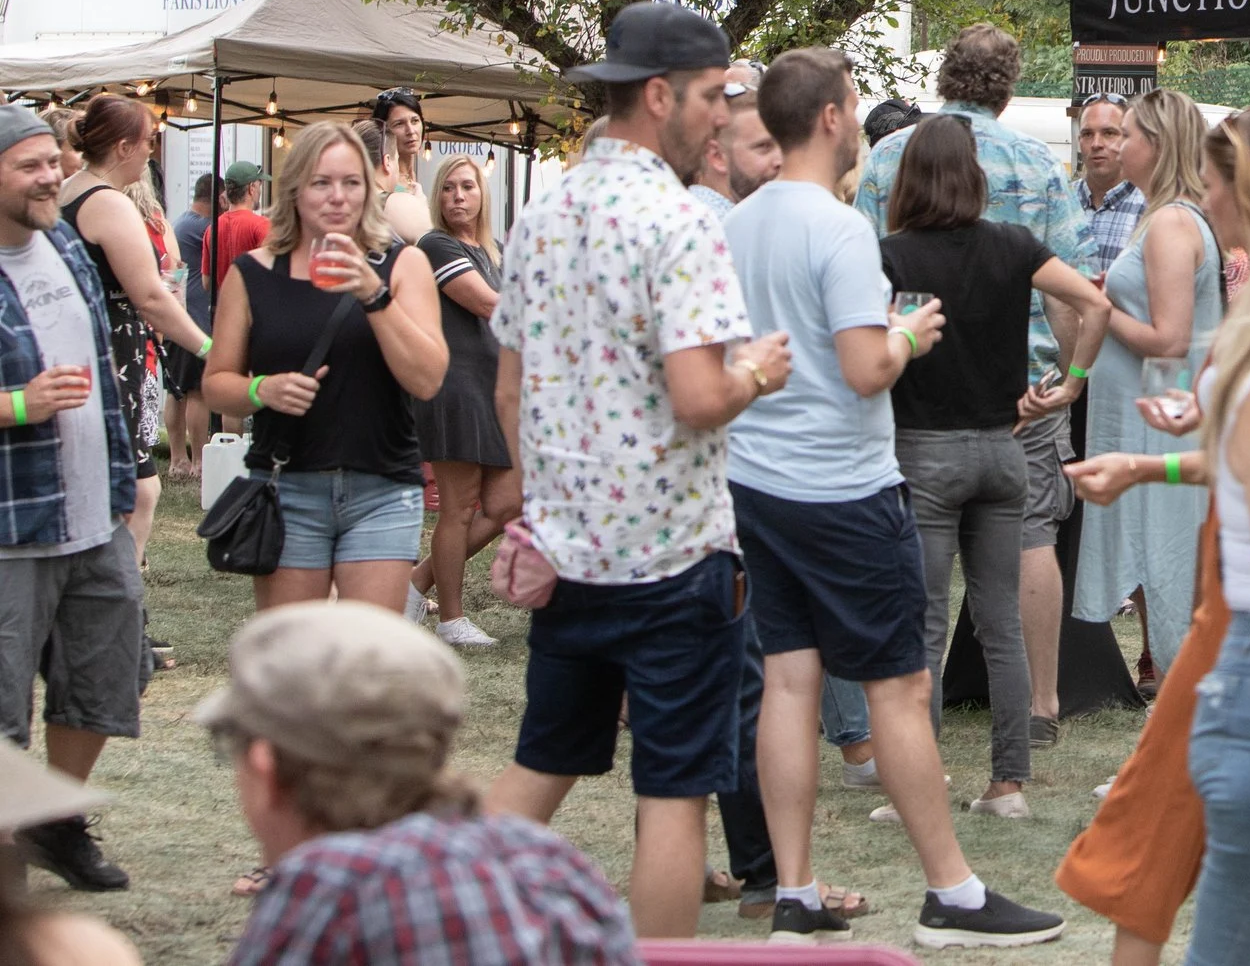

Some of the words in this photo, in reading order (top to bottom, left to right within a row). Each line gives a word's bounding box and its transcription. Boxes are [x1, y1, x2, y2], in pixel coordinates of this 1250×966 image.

[1076, 48, 1108, 62] PROUDLY
[1109, 49, 1145, 62] PRODUCED
[1146, 50, 1154, 62] IN
[1075, 76, 1137, 95] STRATFORD,
[438, 141, 484, 155] ORDER
[25, 285, 74, 309] AKINE
